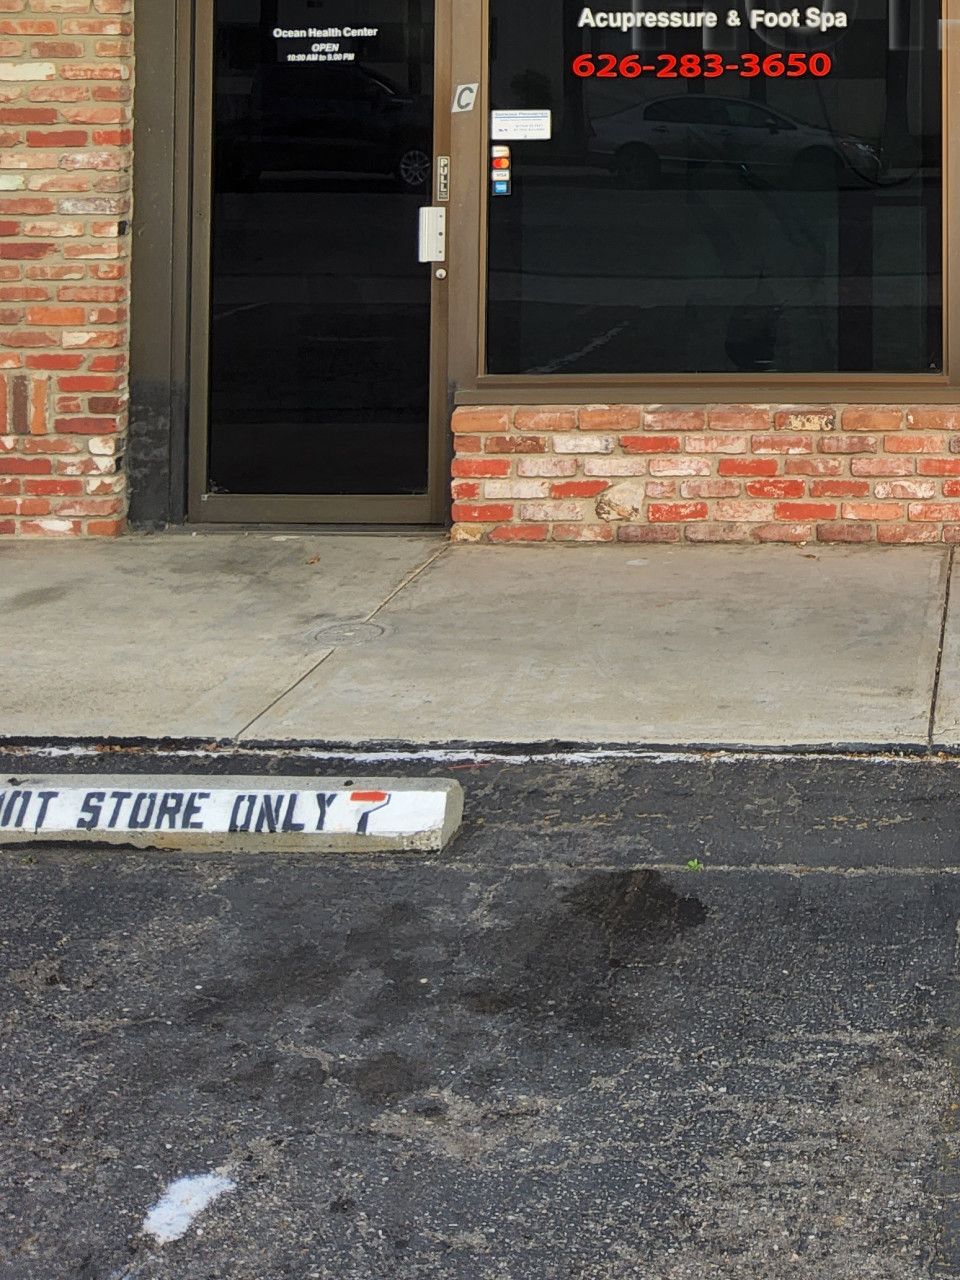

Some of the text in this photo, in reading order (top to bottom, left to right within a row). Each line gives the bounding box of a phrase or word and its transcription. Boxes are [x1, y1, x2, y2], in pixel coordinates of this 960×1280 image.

[273, 26, 379, 38] Ocean Health Center
[578, 7, 848, 32] Acupressure & Foot Spa
[311, 43, 339, 52] OPEN
[571, 51, 833, 78] 626-283-3650
[457, 86, 474, 109] C
[440, 158, 448, 191] PULL
[76, 791, 211, 829] STORE
[227, 792, 338, 833] ONLY
